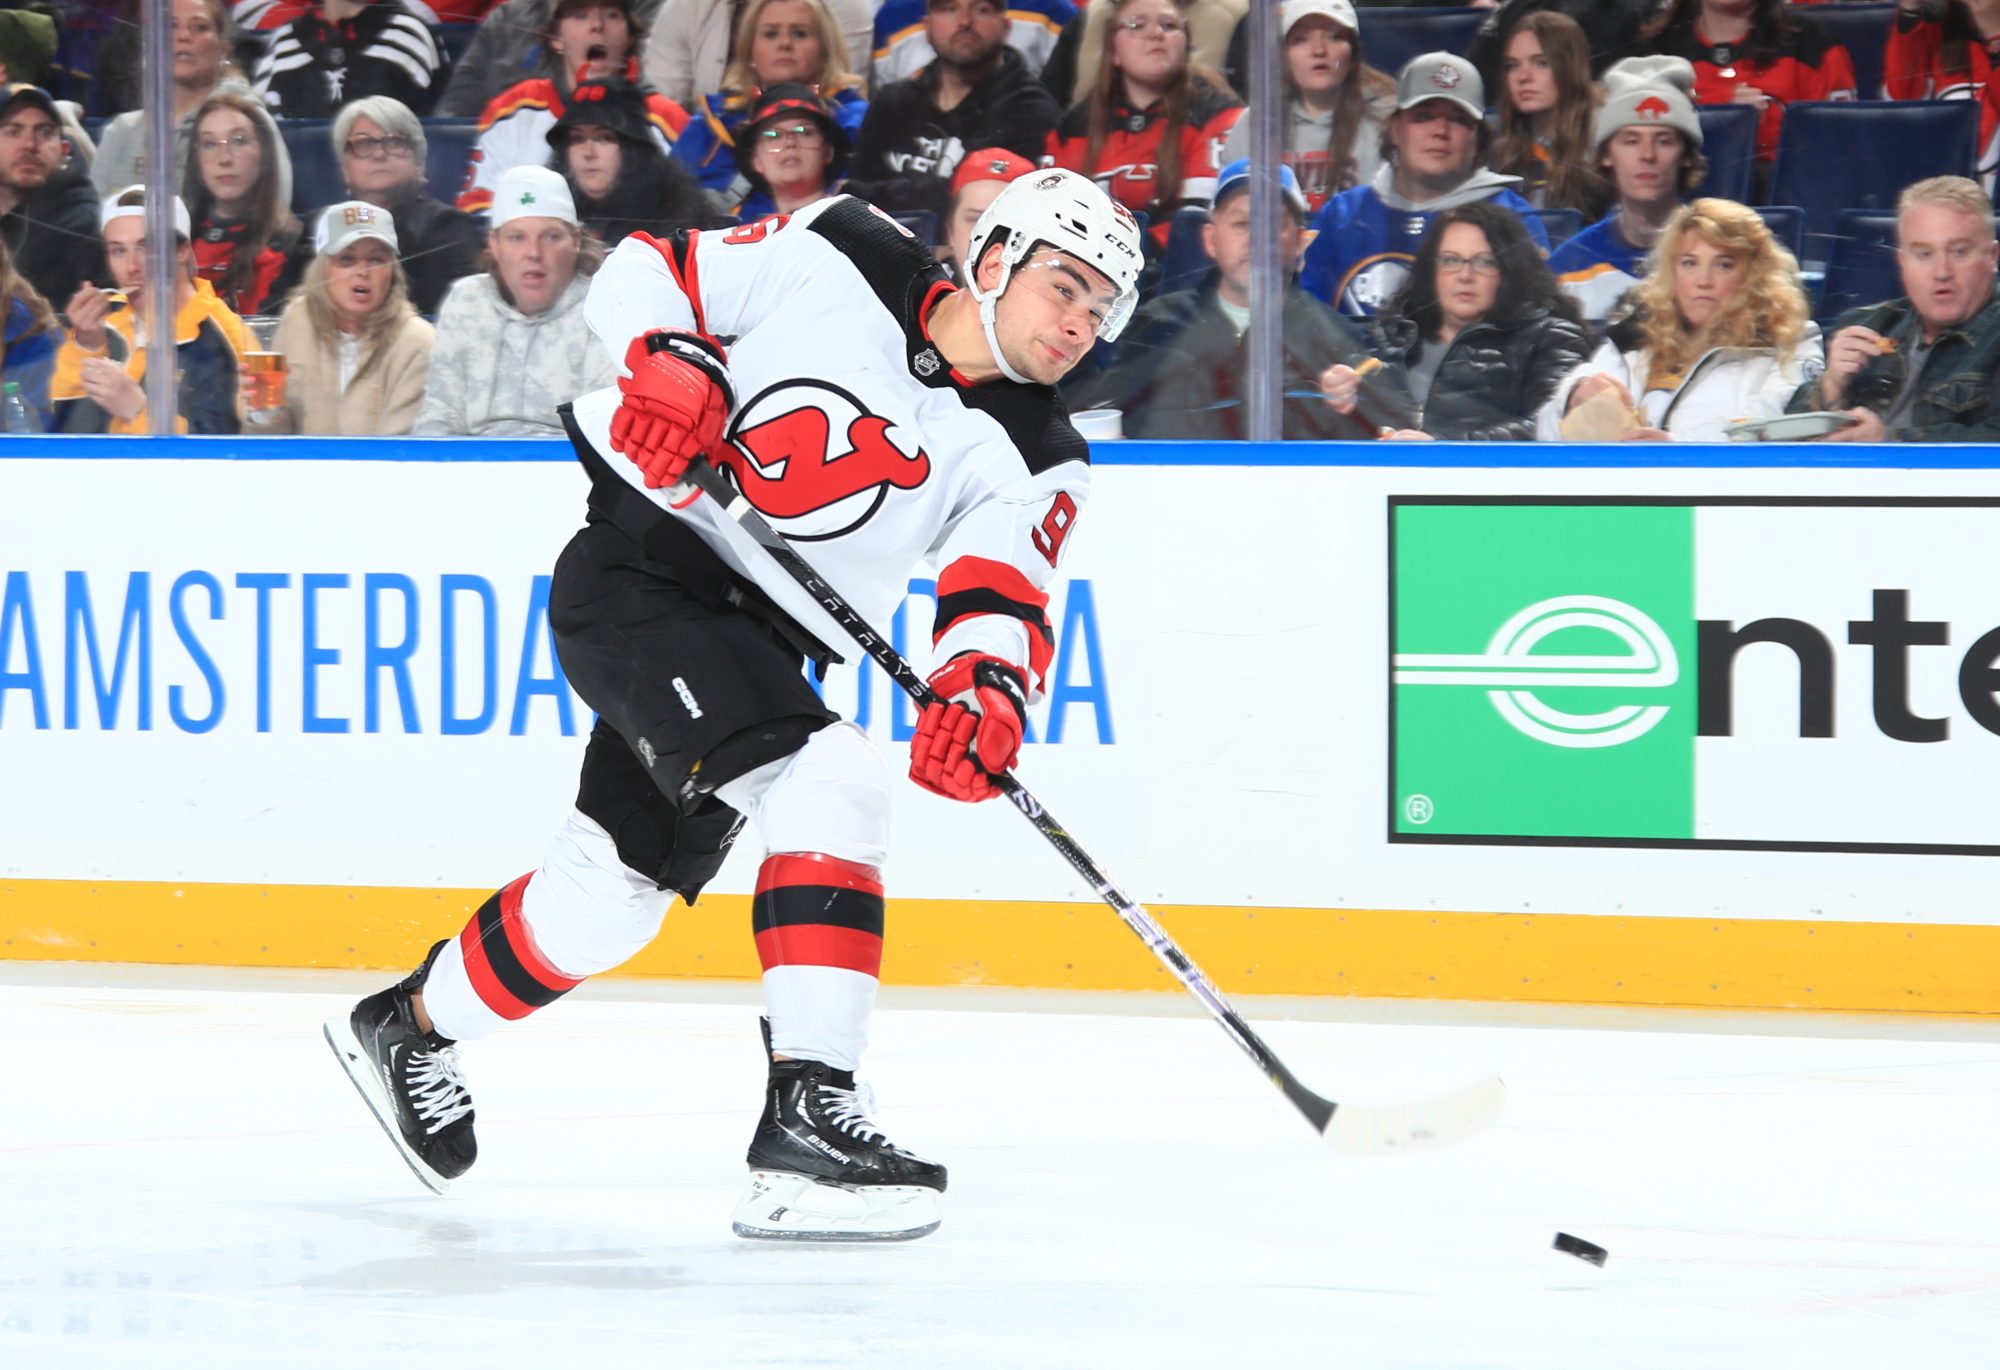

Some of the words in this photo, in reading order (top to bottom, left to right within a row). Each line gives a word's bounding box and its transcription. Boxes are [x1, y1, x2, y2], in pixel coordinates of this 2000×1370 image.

[1104, 232, 1136, 259] CCM
[0, 569, 597, 738] AMSTERDA
[806, 578, 928, 697] CATALYS
[671, 676, 704, 720] CCM
[806, 1133, 851, 1165] BAUER
